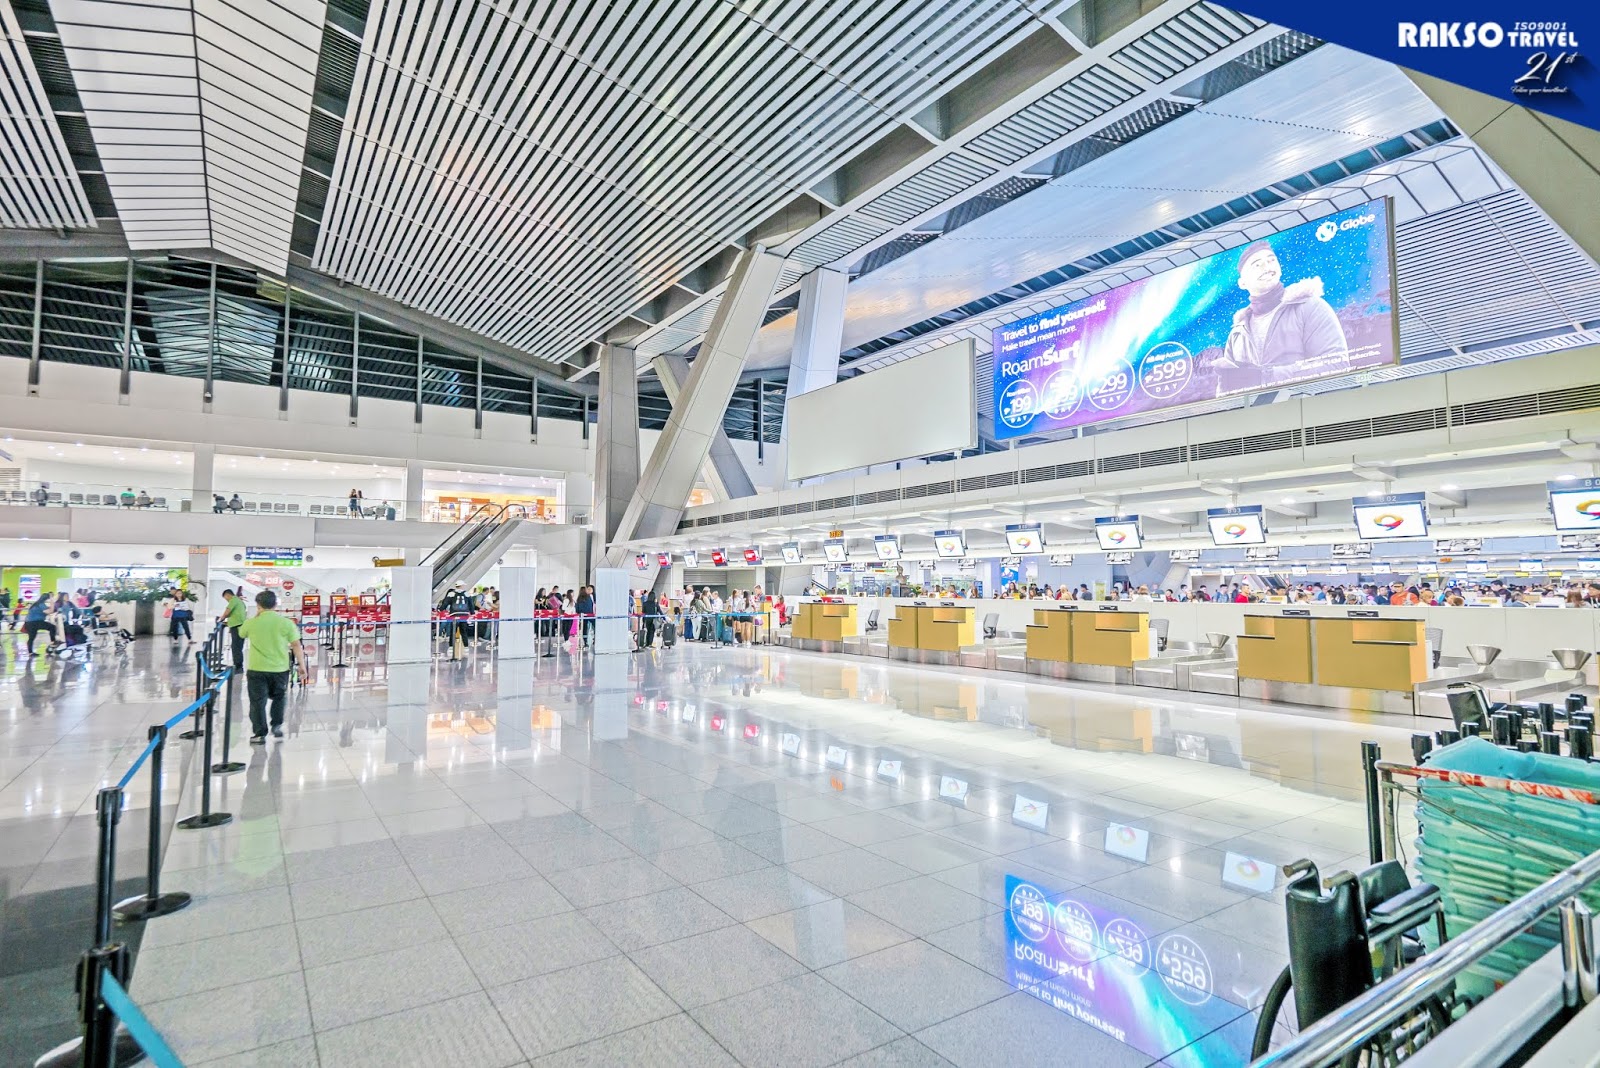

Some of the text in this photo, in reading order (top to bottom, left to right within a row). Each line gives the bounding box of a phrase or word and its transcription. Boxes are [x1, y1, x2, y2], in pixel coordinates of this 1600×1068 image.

[1340, 214, 1376, 231] Globe
[1001, 325, 1078, 353] Make travel mean more.
[1002, 325, 1028, 342] Travel
[1028, 324, 1039, 334] to
[1039, 313, 1061, 331] find
[1002, 340, 1081, 377] RoamSurf
